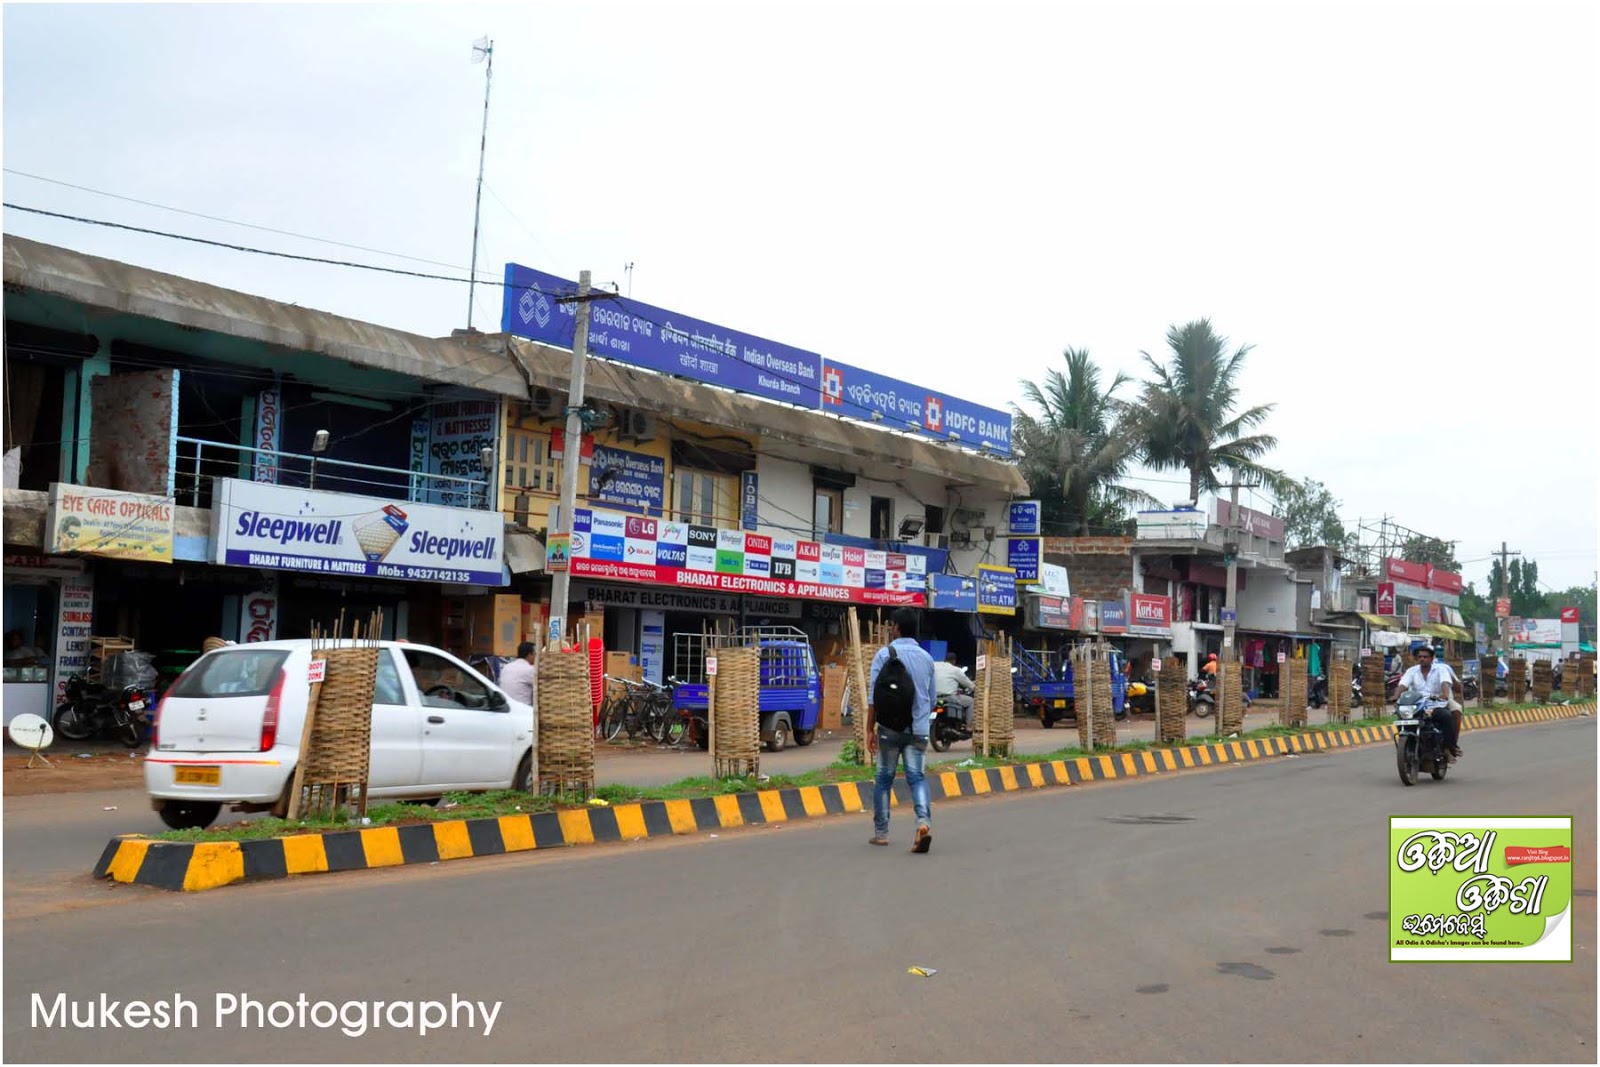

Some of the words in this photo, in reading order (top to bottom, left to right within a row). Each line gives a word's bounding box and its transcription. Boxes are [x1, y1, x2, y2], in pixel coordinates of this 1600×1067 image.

[699, 360, 719, 374] शाखा
[743, 346, 765, 367] Indian
[766, 353, 797, 376] Overseas
[798, 362, 815, 379] Bank
[758, 375, 779, 390] Khurda
[780, 380, 801, 395] Branch
[945, 410, 976, 434] HDFC
[978, 419, 1008, 442] BANK
[63, 495, 84, 513] EYE
[87, 498, 116, 516] CARE
[120, 501, 171, 521] OPTICALS
[235, 511, 342, 545] Sleepwell
[593, 518, 624, 529] Panasonic
[689, 529, 716, 543] SONY
[409, 530, 496, 561] Sleepwell
[747, 537, 769, 550] ONIDA
[773, 541, 795, 553] PHILIPS
[657, 549, 686, 562] VOLTAS
[799, 545, 819, 557] AKAI
[844, 551, 863, 563] Haier
[249, 553, 280, 566] BHARAT
[281, 556, 322, 570] FURNITURE
[323, 560, 330, 571] &
[331, 561, 366, 574] MATTRESS
[377, 565, 404, 577] Mob:
[407, 568, 470, 582] 9437142135
[774, 562, 792, 576] IFB
[1016, 570, 1036, 579] TM
[677, 571, 719, 587] BHARAT
[721, 576, 785, 594] ELECTRONICS
[787, 583, 795, 594] &
[797, 584, 849, 599] APPLIANCES
[587, 587, 637, 601] BHARAT
[641, 591, 716, 609] ELECTRONICS
[719, 599, 727, 610] &
[998, 595, 1014, 606] ATM
[1136, 600, 1163, 618] Kurl-on
[62, 627, 91, 638] CONTACT
[66, 641, 84, 652] LENS
[309, 662, 323, 671] BODY
[308, 672, 322, 680] ZONE
